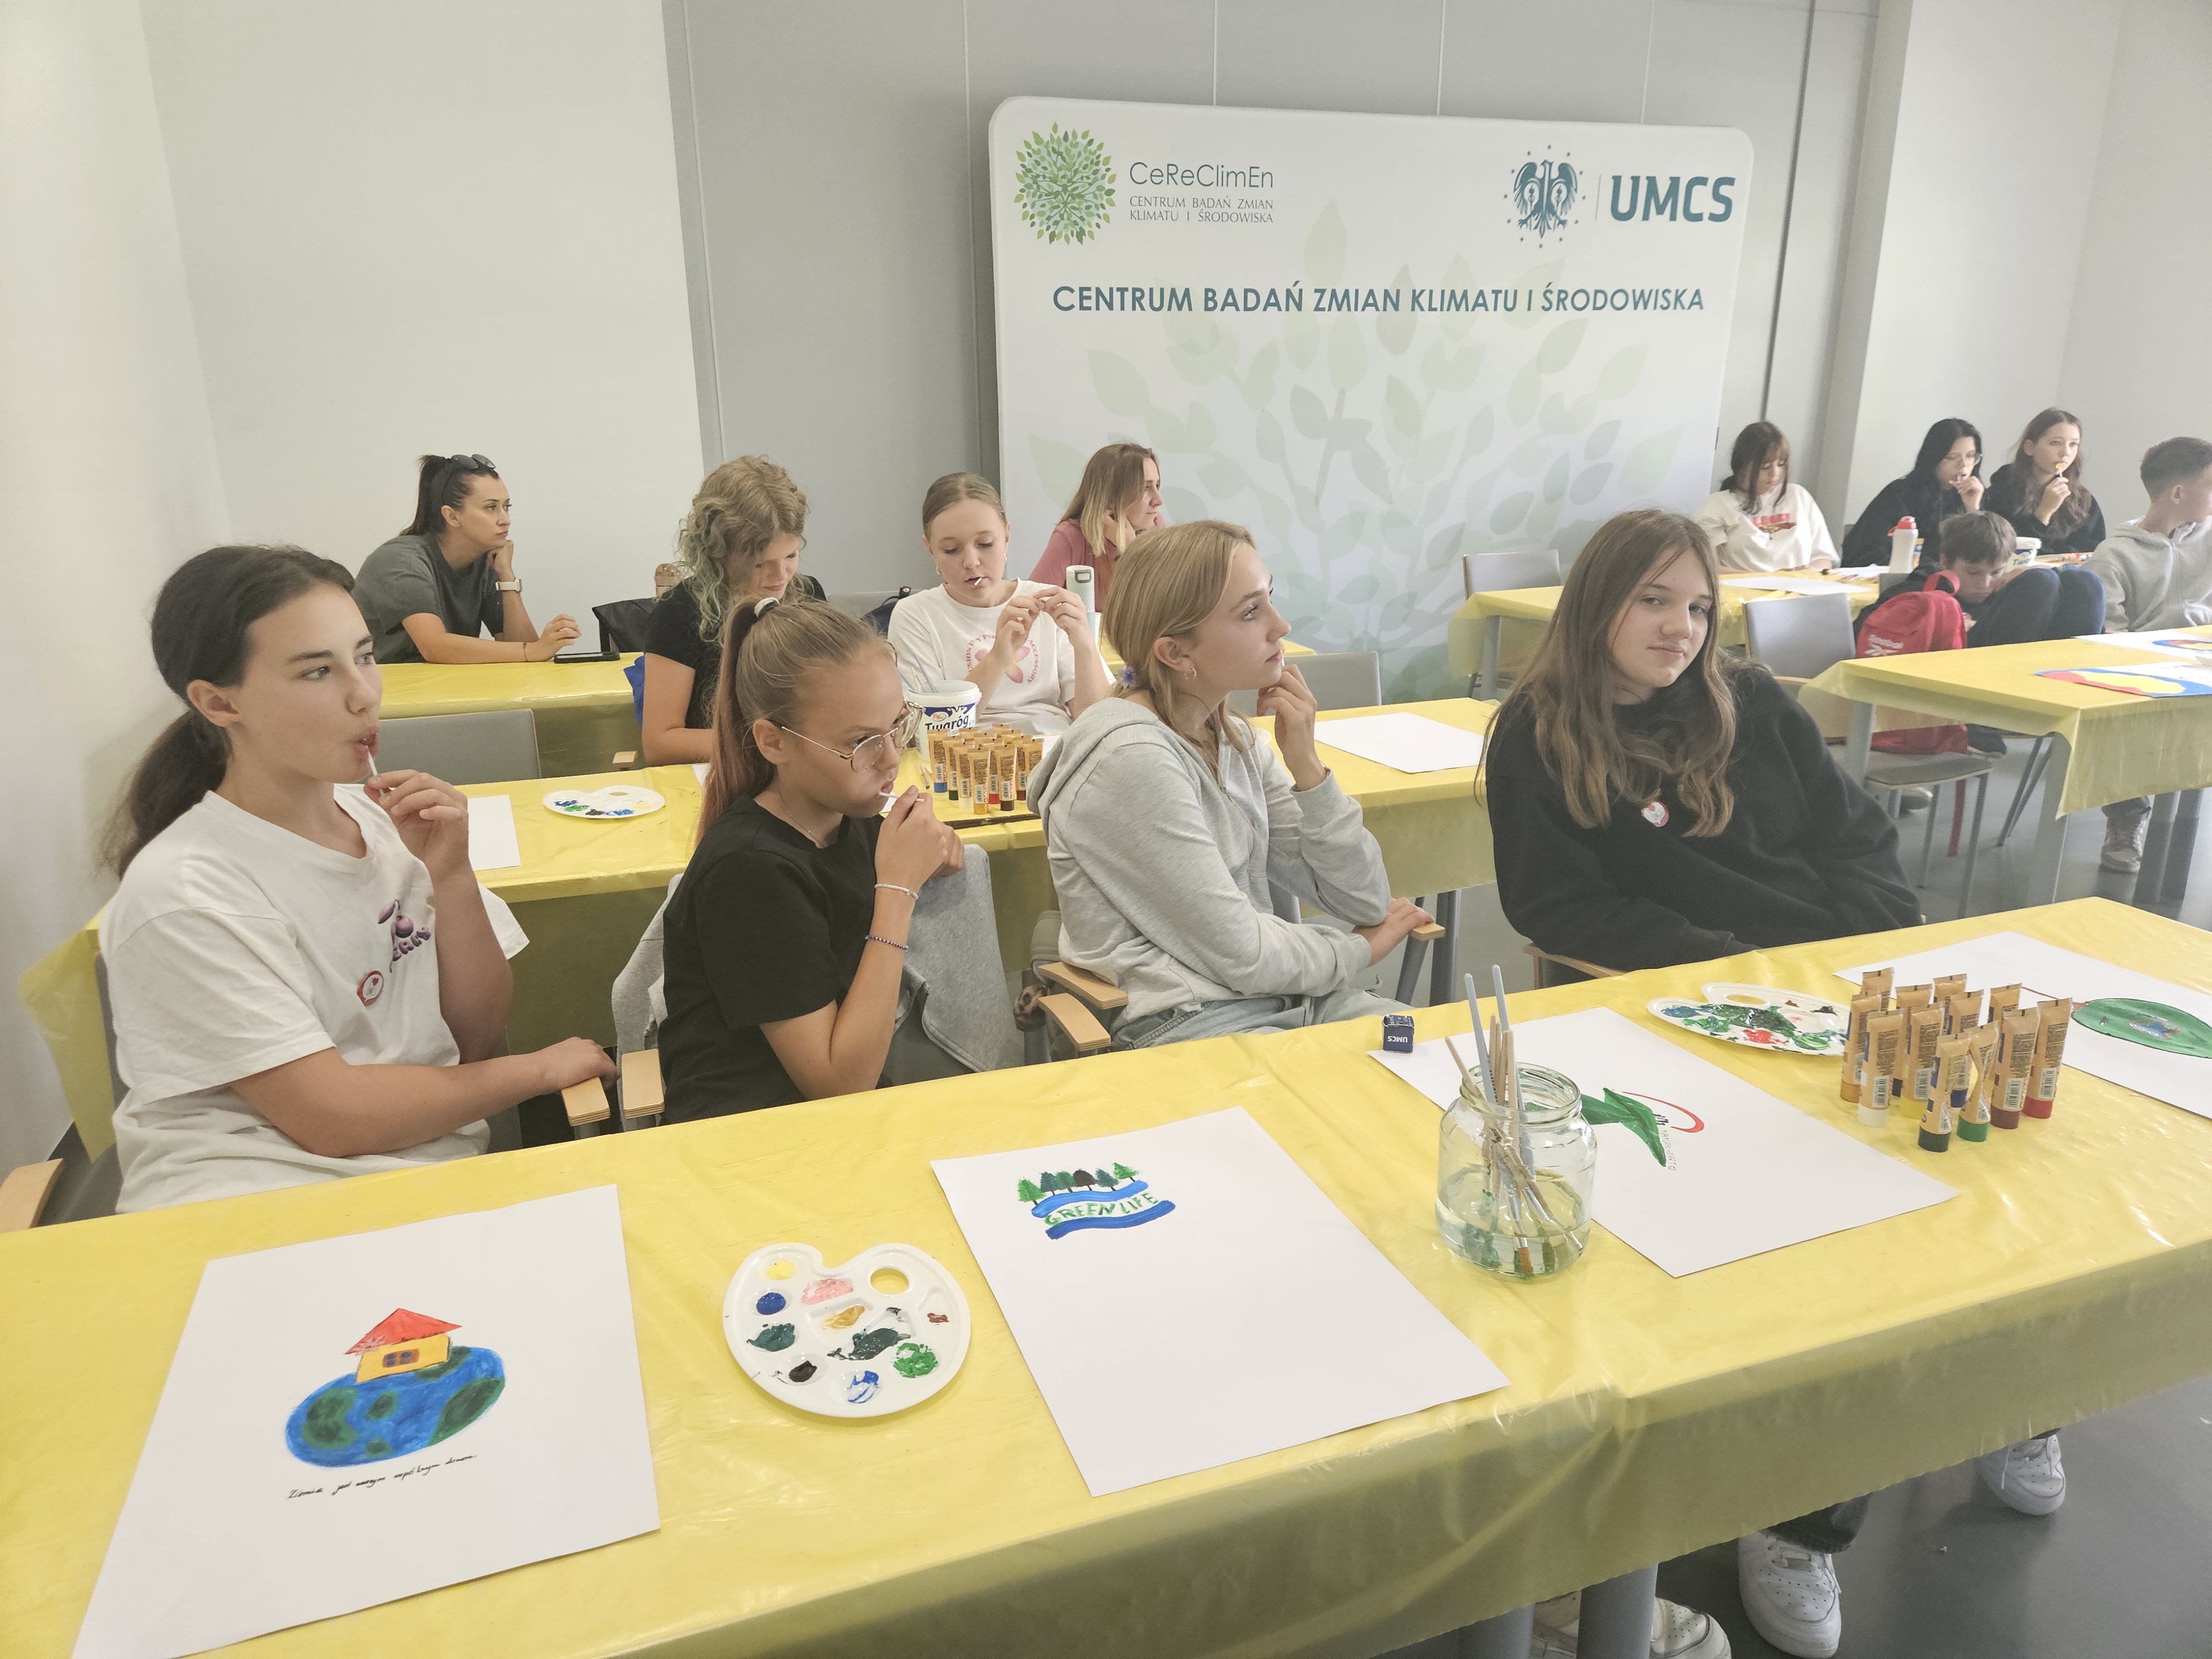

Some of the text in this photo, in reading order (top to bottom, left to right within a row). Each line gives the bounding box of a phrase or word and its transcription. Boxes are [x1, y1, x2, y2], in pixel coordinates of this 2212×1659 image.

[1129, 161, 1273, 188] CeReClimEn
[1130, 195, 1273, 210] CENTRUM BADAŃ ZMIAN
[1610, 175, 1736, 222] UMCS
[1130, 208, 1273, 223] KLIMATU I ŚRODOWISKA
[1053, 280, 1704, 312] CENTRUM BADAŃ ZMIAN KLIMATU I ŚRODOWISKA
[1027, 639, 1039, 685] ACCESSORY
[1044, 1192, 1159, 1226] GREEN LIFE
